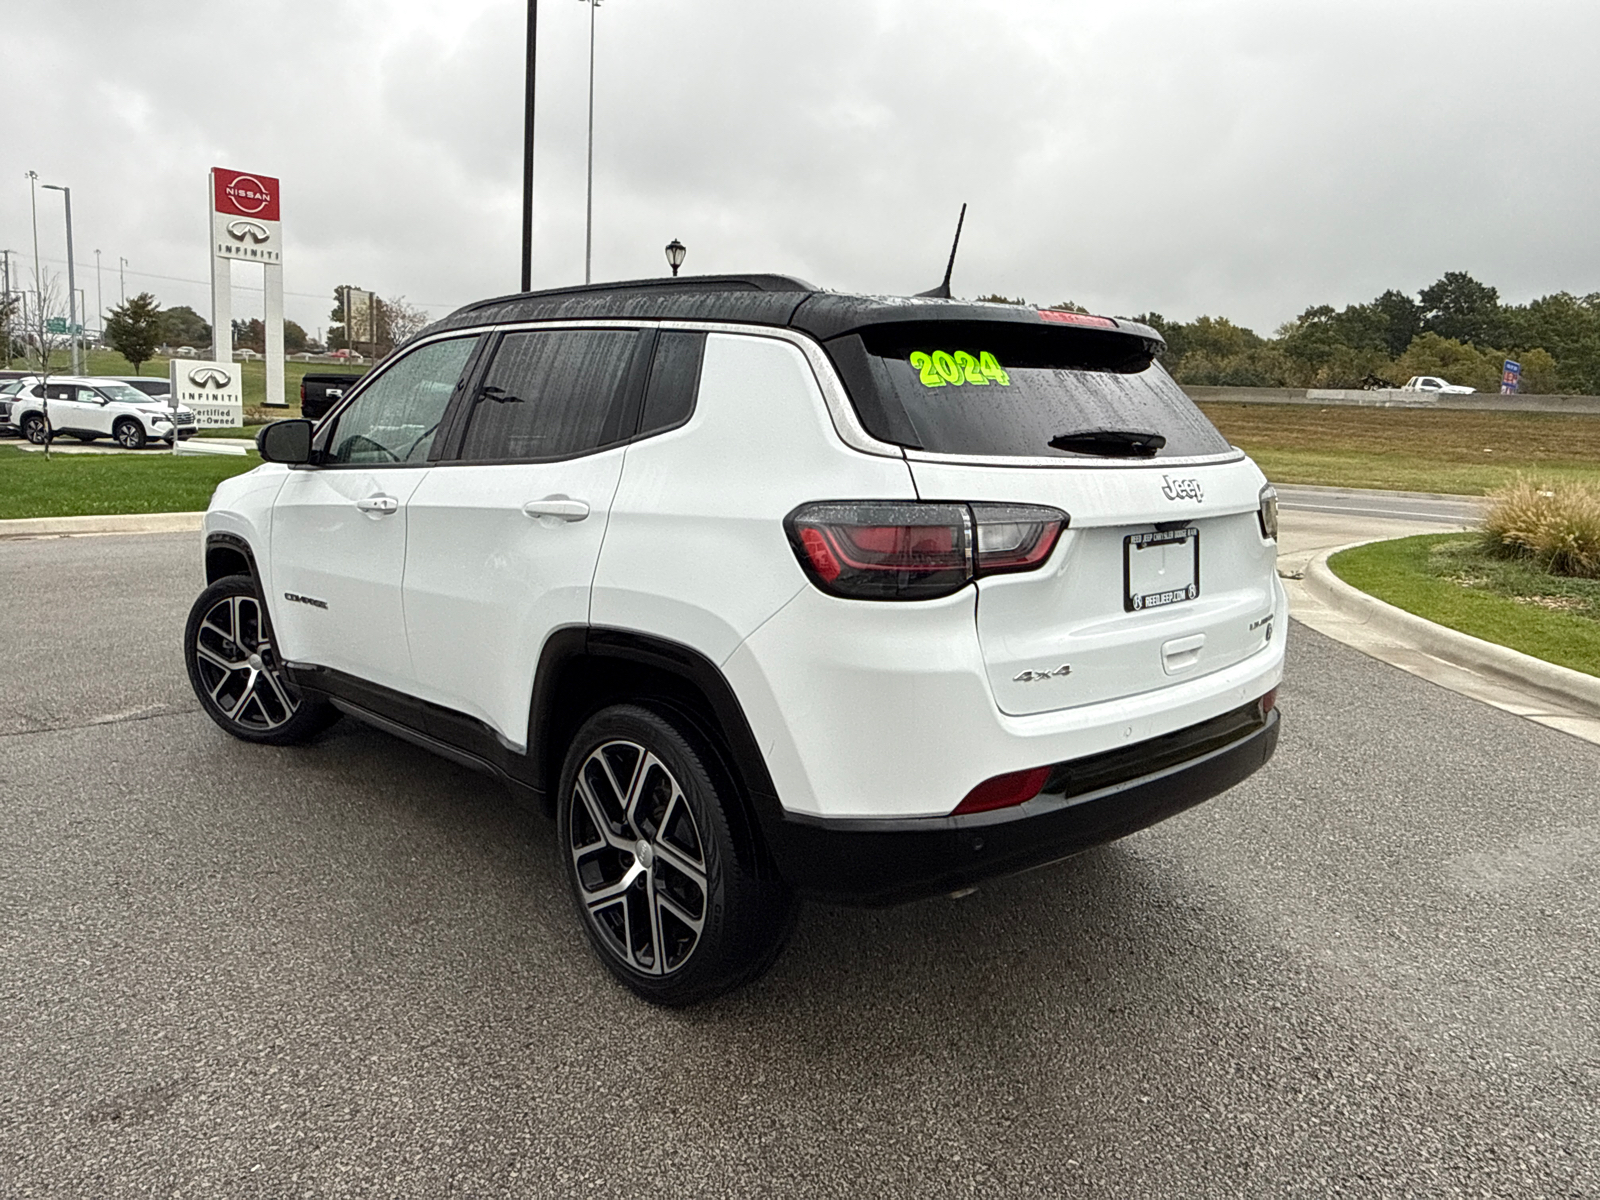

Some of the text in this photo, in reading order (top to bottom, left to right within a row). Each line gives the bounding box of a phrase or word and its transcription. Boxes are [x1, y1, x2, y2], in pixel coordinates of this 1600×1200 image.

[226, 187, 270, 201] NISSAN
[218, 243, 279, 260] INFINITI
[909, 350, 1010, 388] 2024
[182, 392, 238, 402] INFINITI
[1161, 474, 1204, 503] Jeep
[1131, 534, 1142, 544] REED
[1142, 533, 1153, 543] JEEP
[1145, 590, 1186, 608] REEDJEEP.COM
